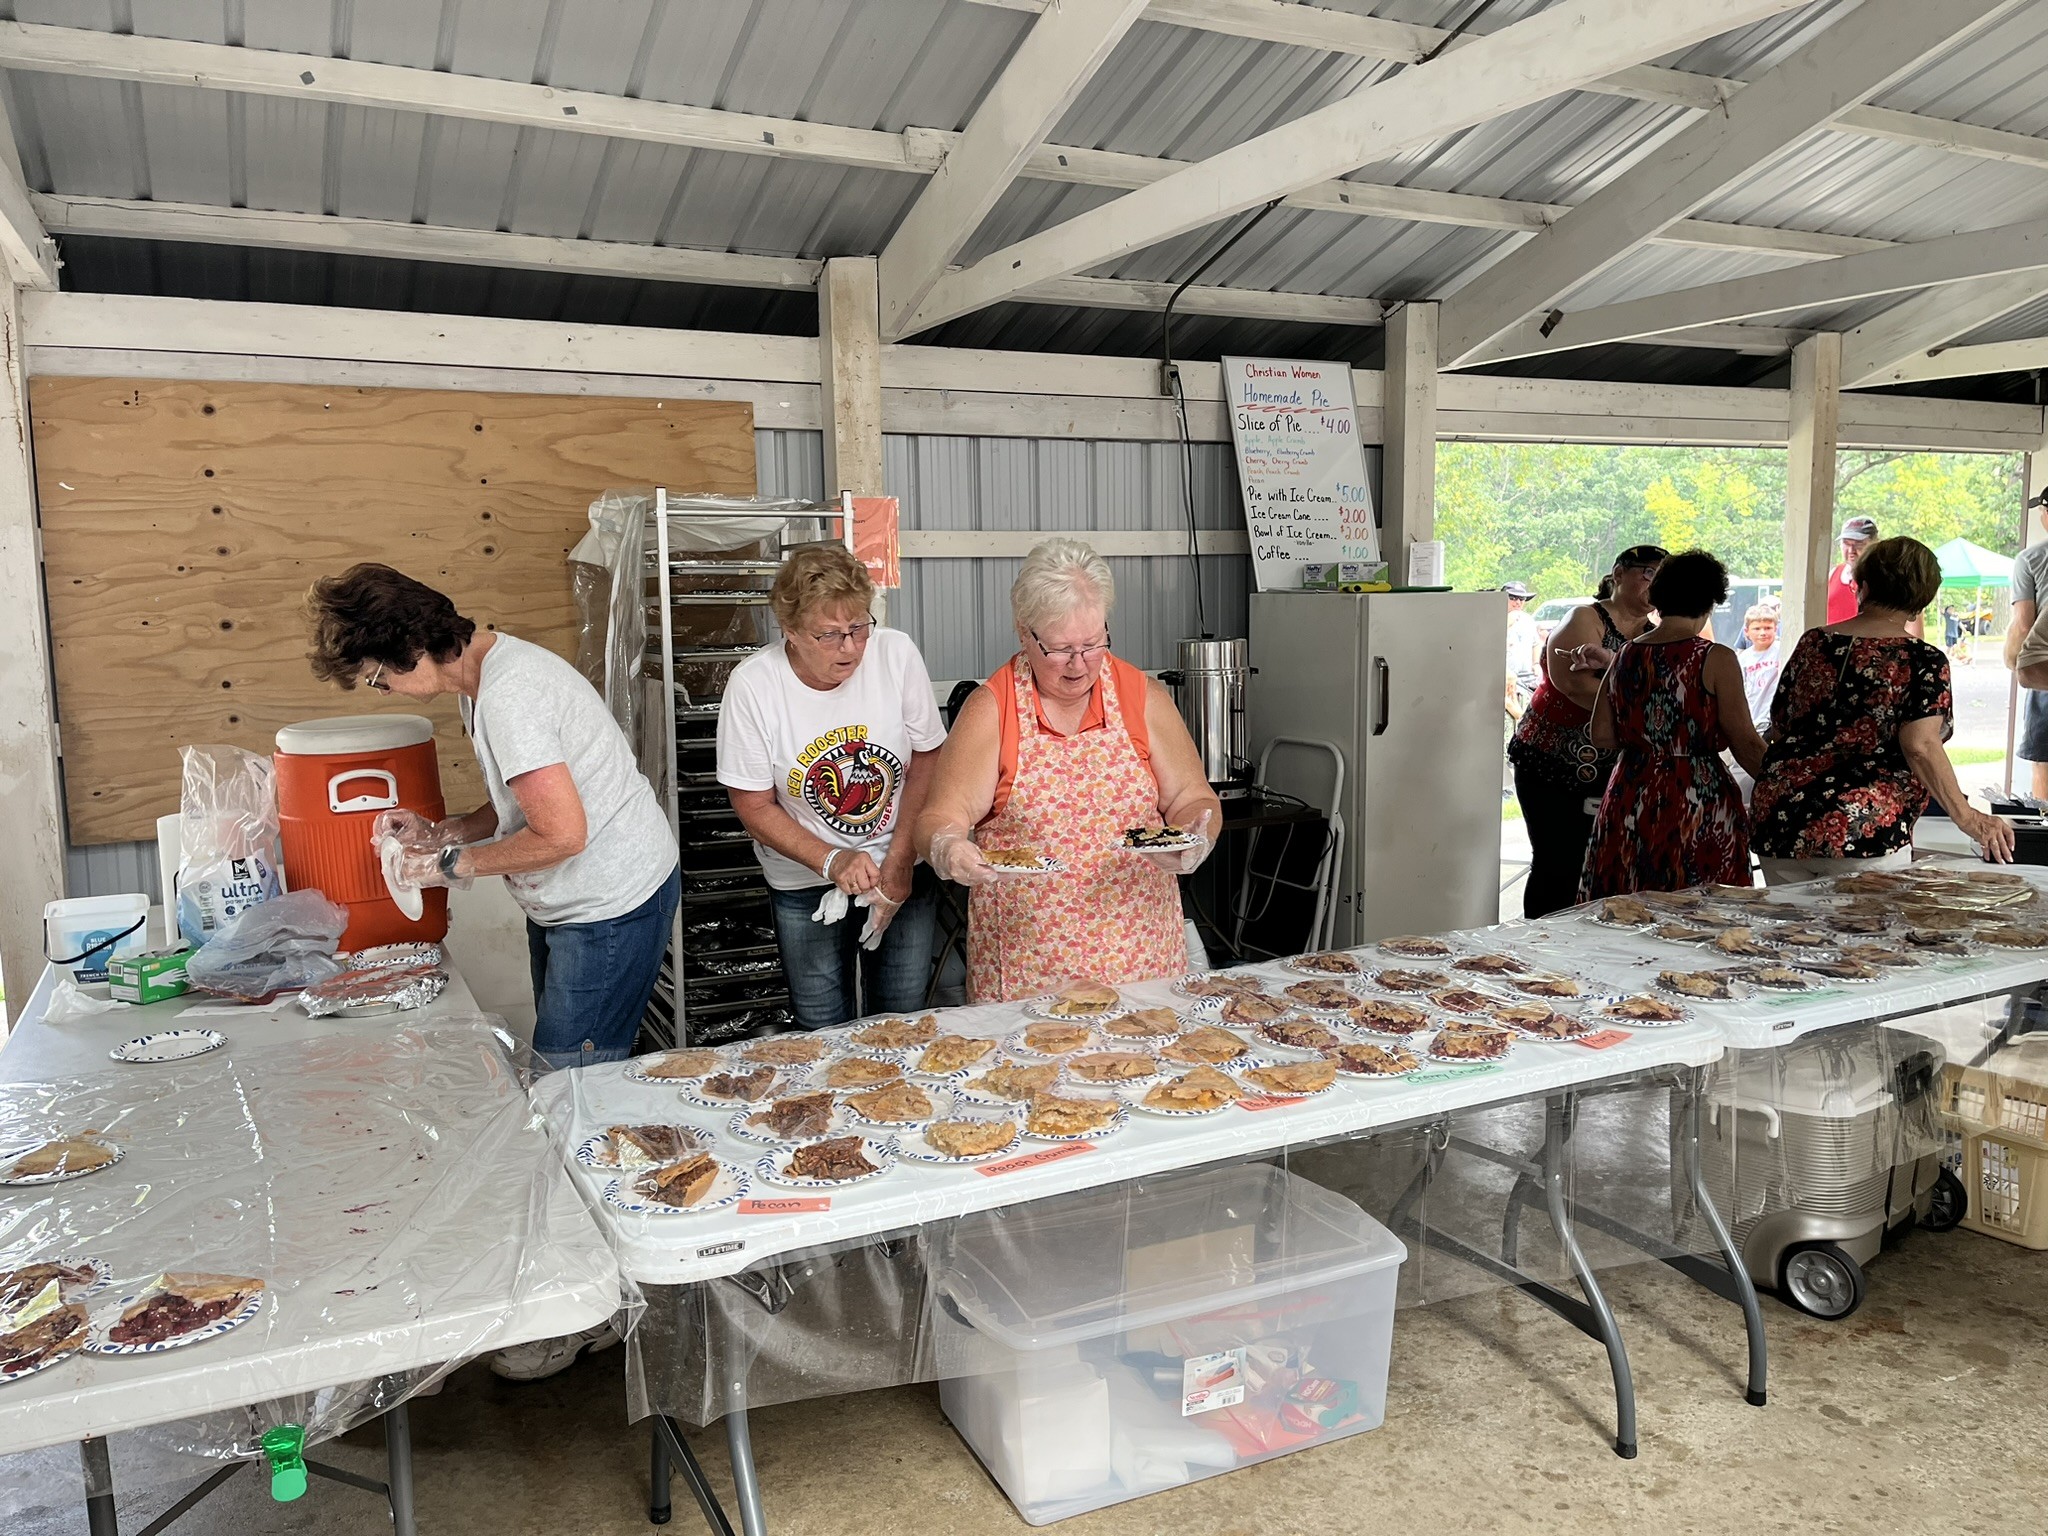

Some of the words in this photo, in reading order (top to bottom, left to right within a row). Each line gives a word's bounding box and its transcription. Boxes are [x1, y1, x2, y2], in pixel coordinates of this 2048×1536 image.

[1245, 363, 1287, 378] Christian
[1291, 365, 1321, 379] Women
[1244, 383, 1303, 405] Homemade
[1312, 389, 1330, 407] Pie
[1238, 413, 1266, 431] Slice
[1269, 413, 1283, 432] of
[1285, 414, 1302, 433] Pie
[1321, 415, 1351, 434] $4.00
[1247, 485, 1263, 501] Pie
[1268, 488, 1287, 502] with
[1290, 487, 1305, 503] Ice
[1336, 482, 1366, 503] $5.00
[1251, 505, 1266, 519] Ice
[1268, 506, 1292, 520] Cream
[1293, 508, 1312, 521] Cone
[1338, 505, 1366, 524] $2.00
[1253, 524, 1273, 539] Bowl
[1276, 525, 1284, 537] of
[1286, 525, 1303, 539] Ice
[1340, 525, 1369, 540] $2.00
[1257, 545, 1291, 561] Coffee
[1342, 545, 1369, 560] $1.00
[786, 767, 804, 798] RED
[796, 725, 868, 768] ROOSTER
[986, 1160, 1033, 1173] Peach
[751, 1199, 801, 1210] Pecan
[702, 1242, 741, 1256] LIFETIME
